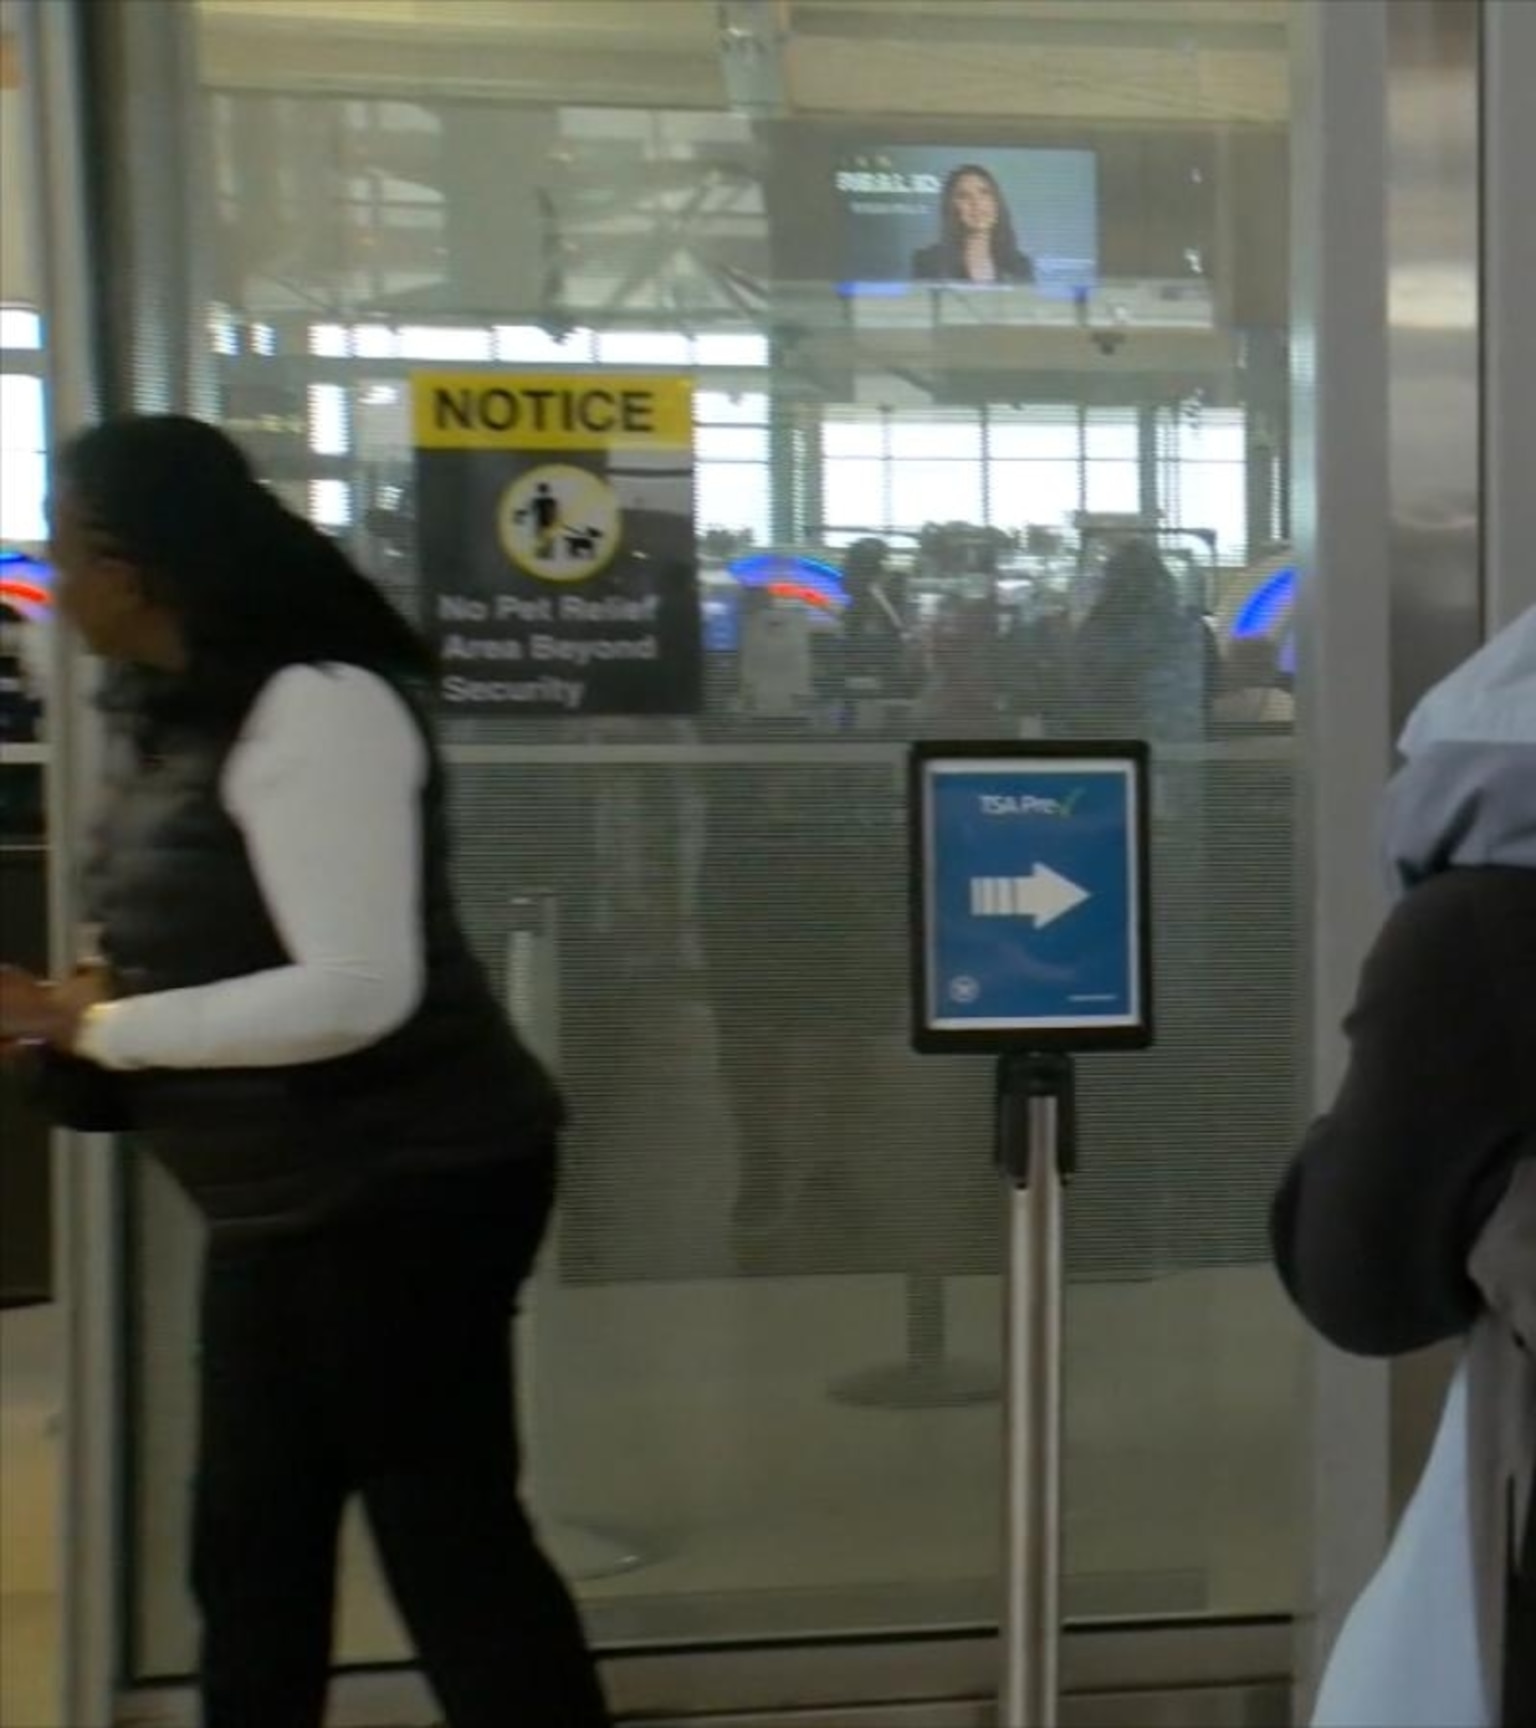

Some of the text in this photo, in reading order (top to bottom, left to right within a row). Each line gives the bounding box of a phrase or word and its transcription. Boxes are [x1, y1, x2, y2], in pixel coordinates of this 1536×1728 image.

[432, 388, 656, 432] NOTICE
[438, 594, 661, 621] No Pet Relief
[442, 634, 658, 665] Area Beyond
[442, 675, 585, 708] Security
[978, 795, 1018, 814] TSA
